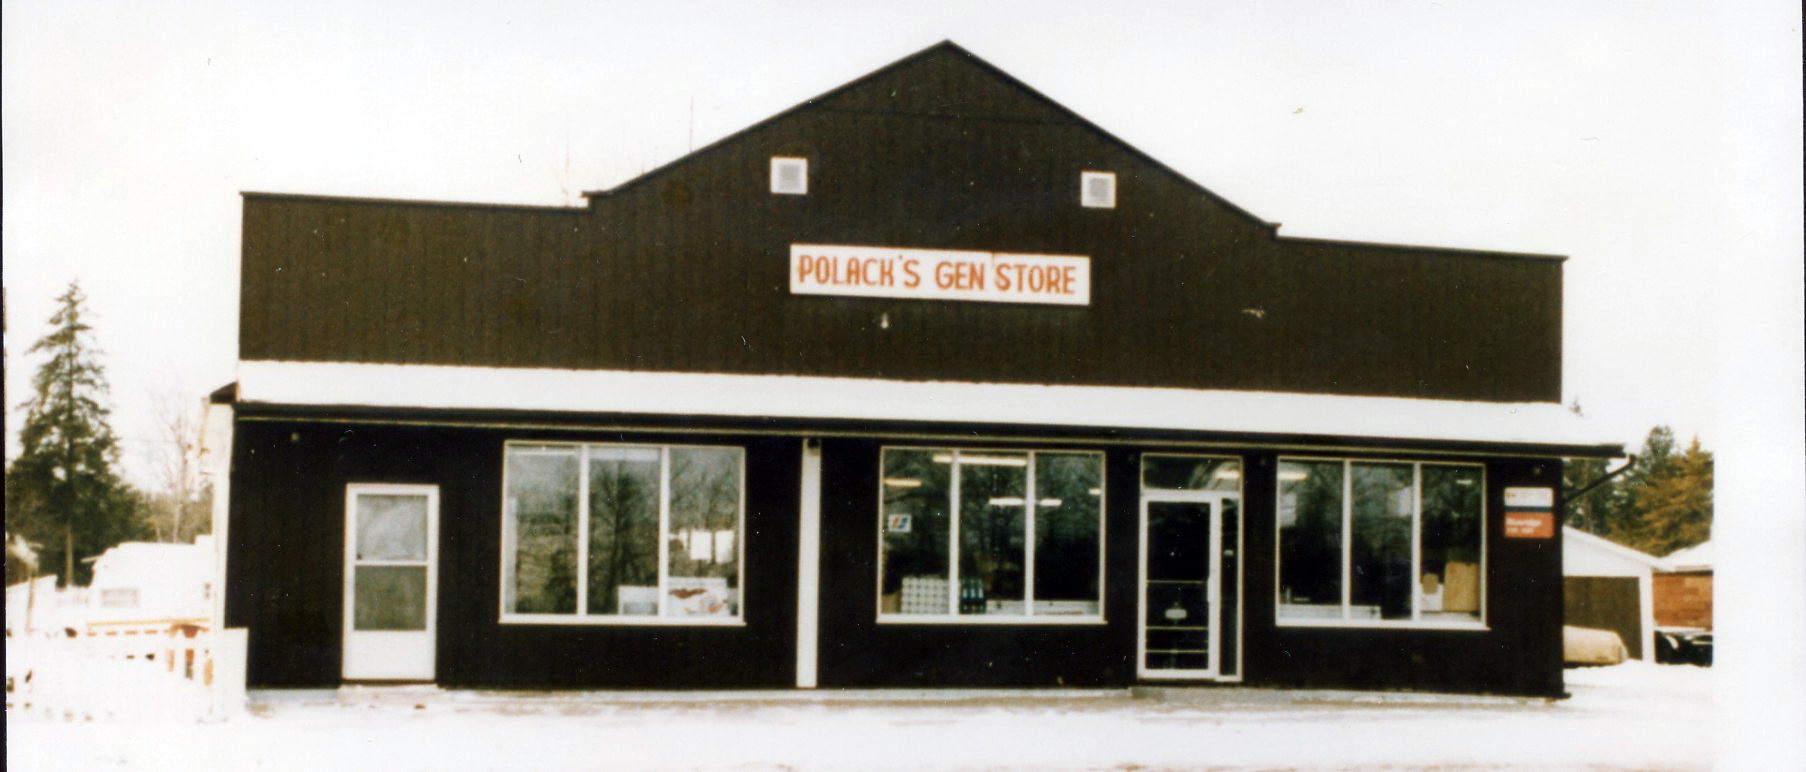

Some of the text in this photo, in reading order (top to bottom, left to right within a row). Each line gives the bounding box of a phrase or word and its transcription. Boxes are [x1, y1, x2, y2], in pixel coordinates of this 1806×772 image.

[798, 254, 1077, 295] POLACK'S GEN STORE
